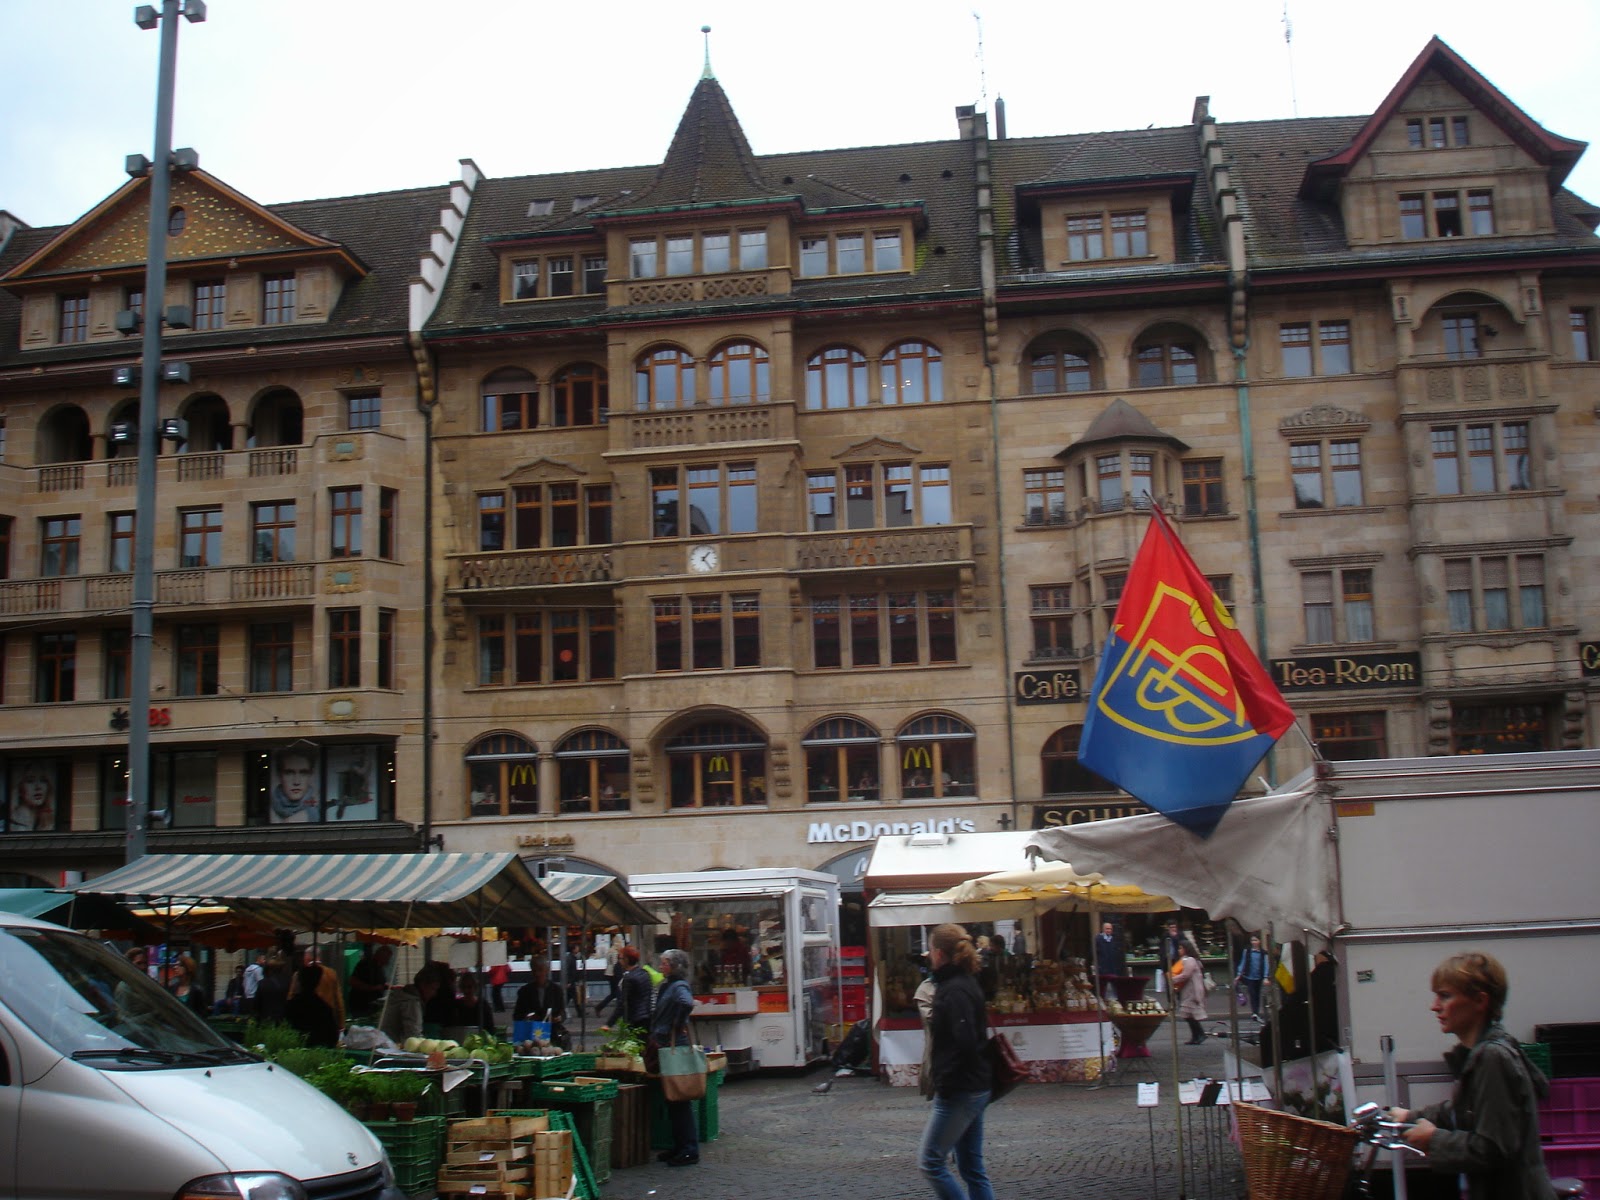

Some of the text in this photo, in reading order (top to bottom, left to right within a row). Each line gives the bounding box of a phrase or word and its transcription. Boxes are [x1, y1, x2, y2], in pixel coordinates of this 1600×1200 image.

[1276, 658, 1414, 686] Tea-Room
[1018, 672, 1078, 699] Café
[148, 708, 171, 726] BS
[807, 817, 976, 843] McDonald's
